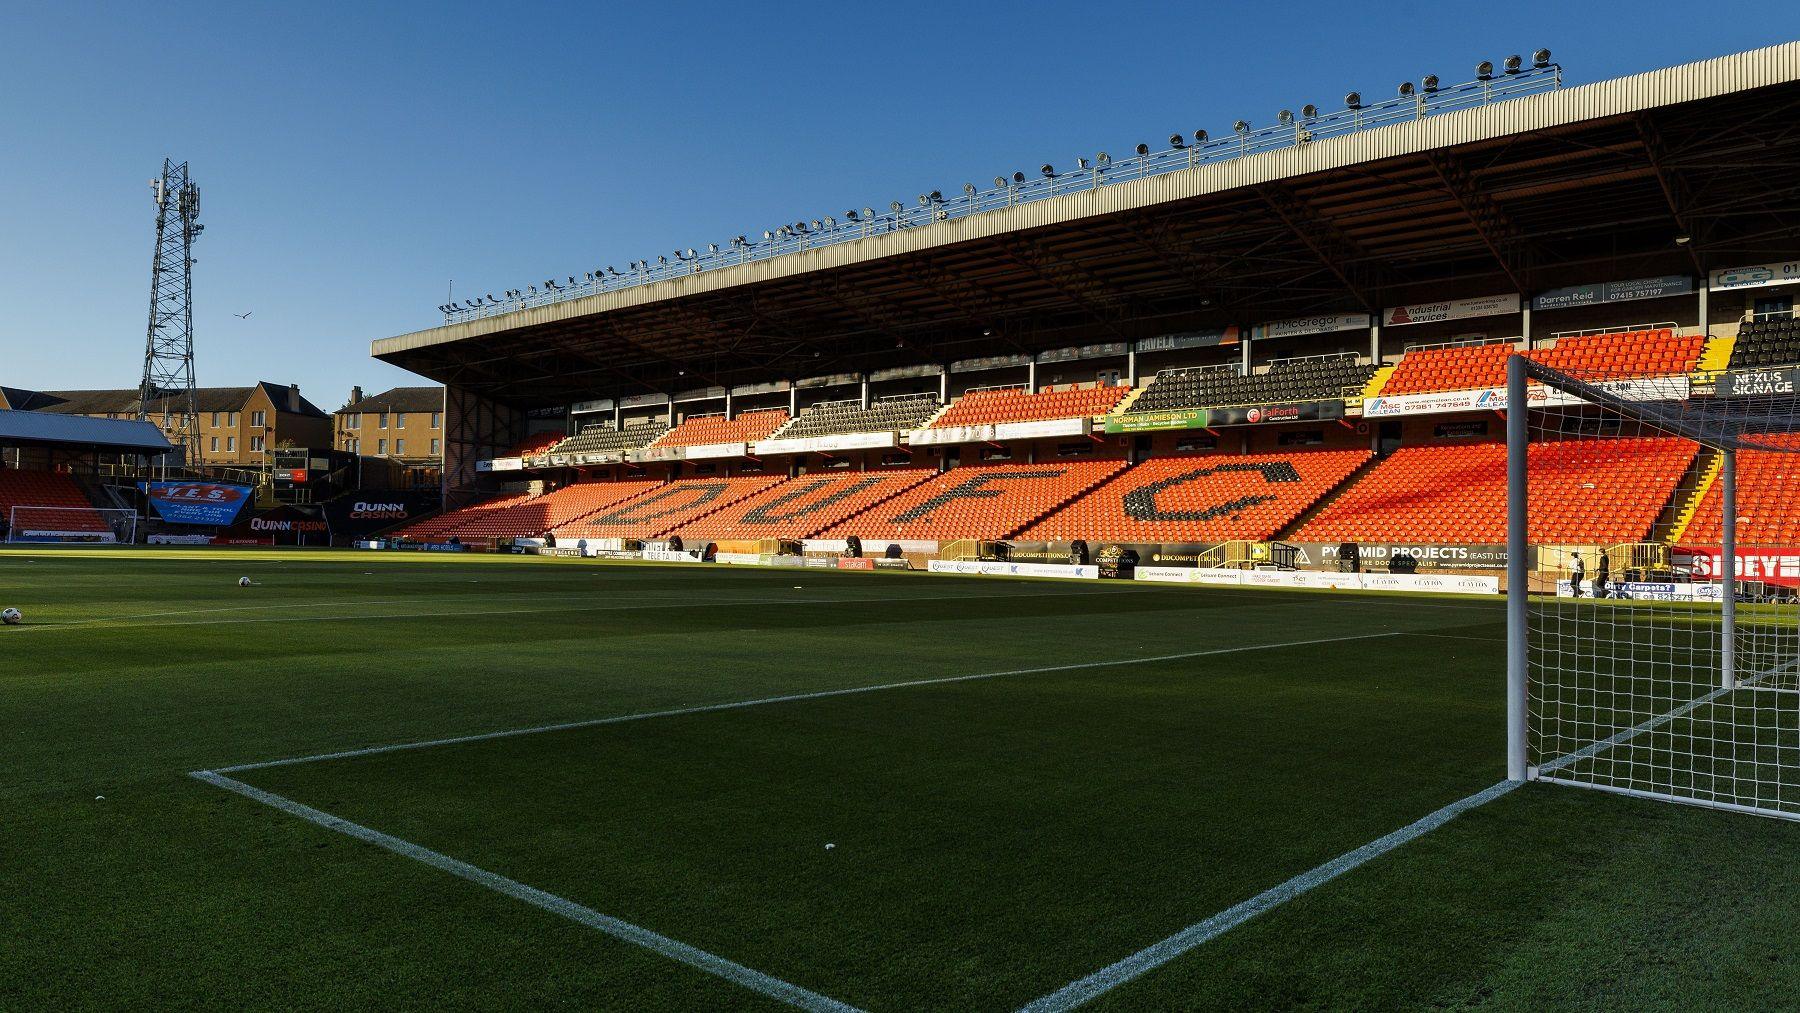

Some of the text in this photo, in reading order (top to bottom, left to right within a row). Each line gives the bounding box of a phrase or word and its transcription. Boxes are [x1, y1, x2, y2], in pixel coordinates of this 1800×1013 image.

[1539, 291, 1594, 304] Darren Reid
[1610, 288, 1663, 300] 07415 757197
[1735, 372, 1782, 385] NEXUS
[1732, 381, 1794, 394] SIGNAGE
[1261, 406, 1299, 417] CalForth
[1113, 416, 1144, 424] NORMAN
[1145, 413, 1182, 422] JAMIESON
[353, 502, 405, 512] QUINN
[349, 511, 408, 519] CASINO
[1322, 547, 1508, 560] PYMID PROJECTS (EAST) LTD
[1628, 583, 1671, 592] Carpets?
